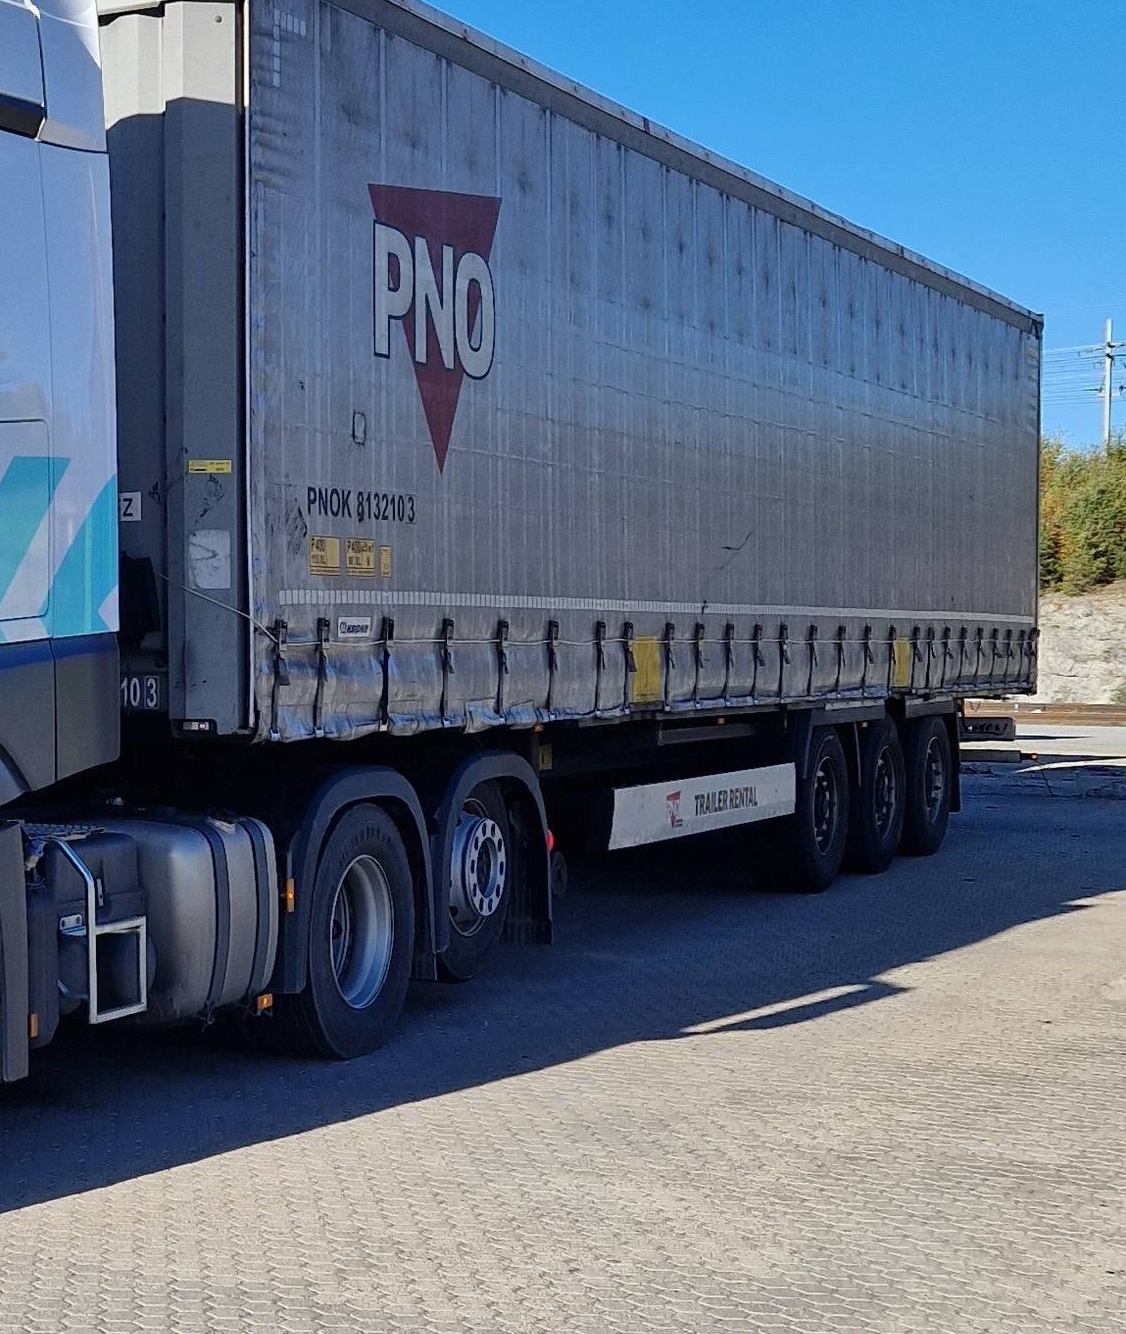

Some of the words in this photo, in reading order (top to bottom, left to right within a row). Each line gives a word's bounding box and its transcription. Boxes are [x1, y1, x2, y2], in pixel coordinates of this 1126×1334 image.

[373, 219, 496, 380] PNO
[118, 498, 134, 517] Z
[307, 486, 352, 518] PNOK
[357, 491, 415, 522] 8132103
[694, 788, 730, 816] TRAILER
[729, 786, 759, 808] RENTAL
